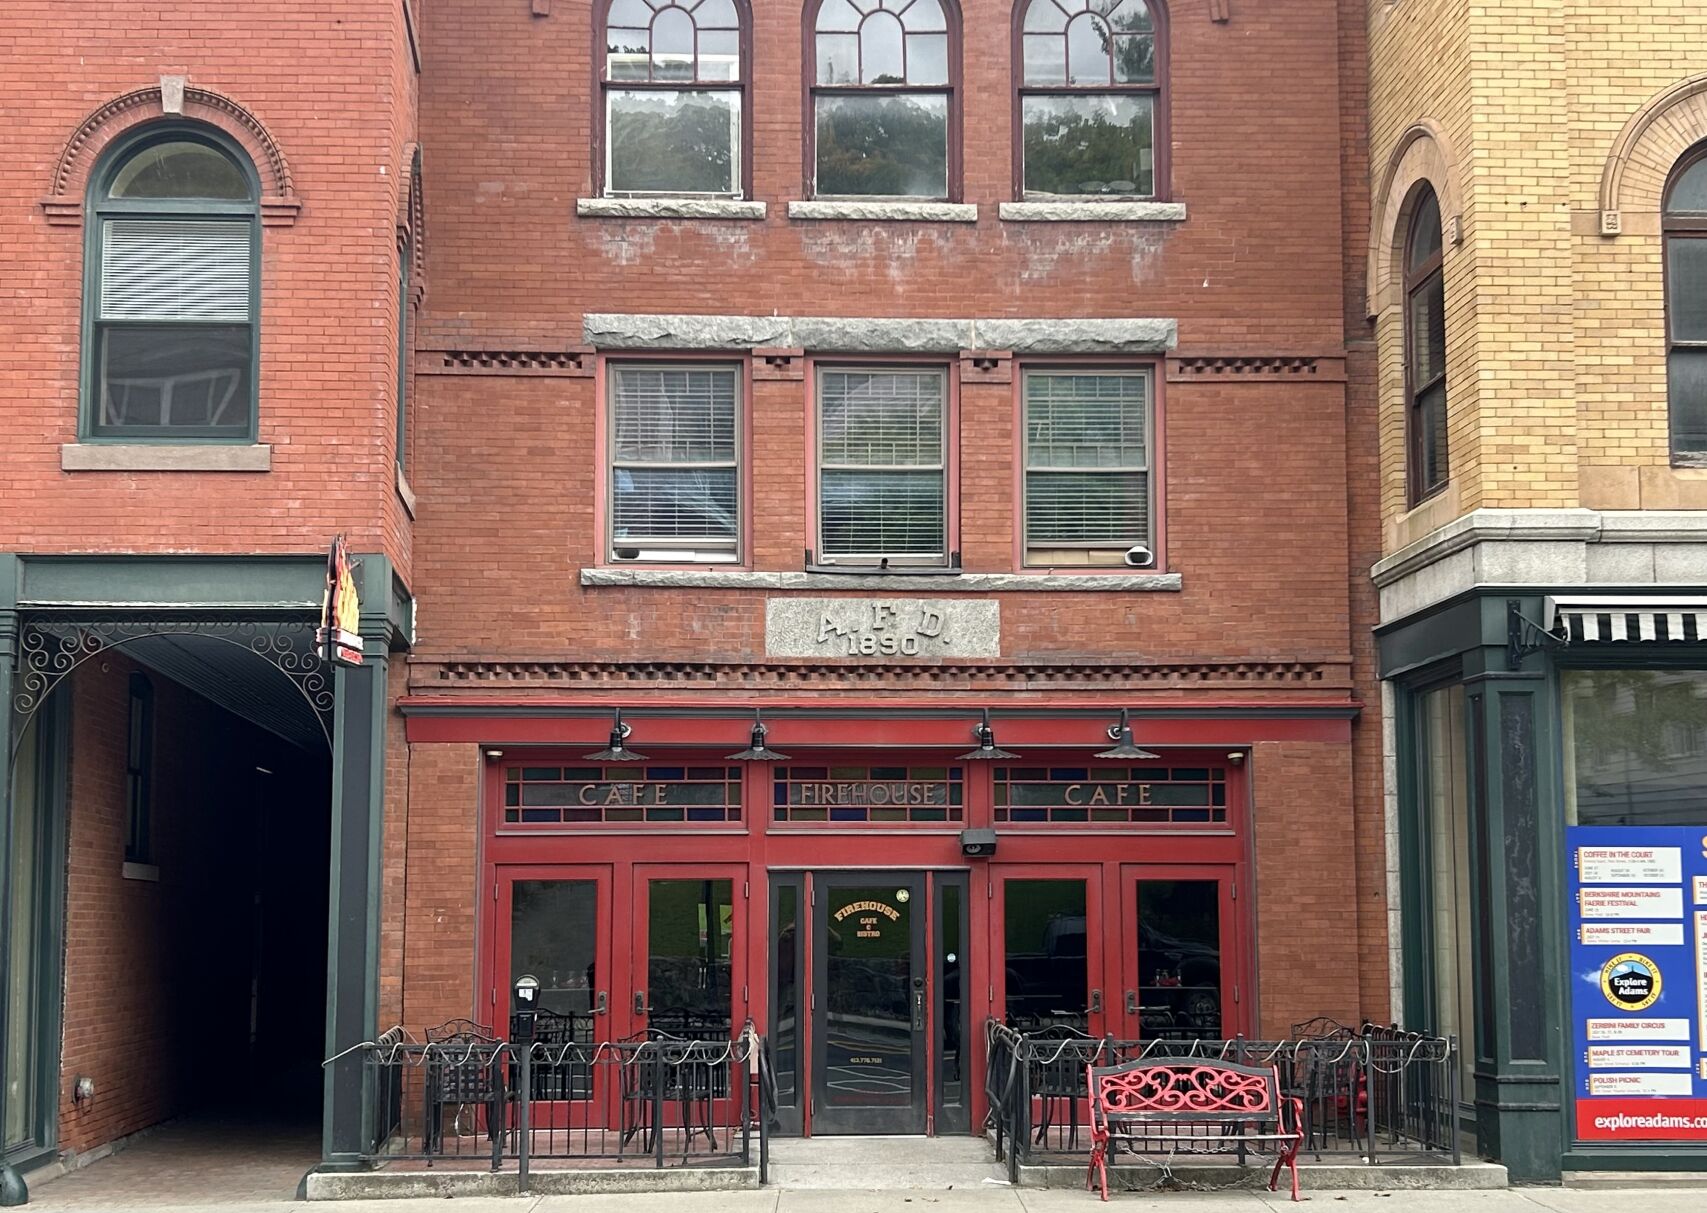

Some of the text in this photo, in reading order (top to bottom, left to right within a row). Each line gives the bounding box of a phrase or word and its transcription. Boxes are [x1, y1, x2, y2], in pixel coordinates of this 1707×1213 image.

[848, 633, 919, 655] 1890
[579, 783, 668, 806] CAFE
[801, 783, 936, 805] FIREHOUSE
[1064, 784, 1152, 806] CAFE
[834, 901, 900, 922] FIREHOUSE
[1614, 978, 1647, 987] Explore
[1618, 987, 1649, 995] Adams
[1594, 1112, 1707, 1131] exploreadams.co
